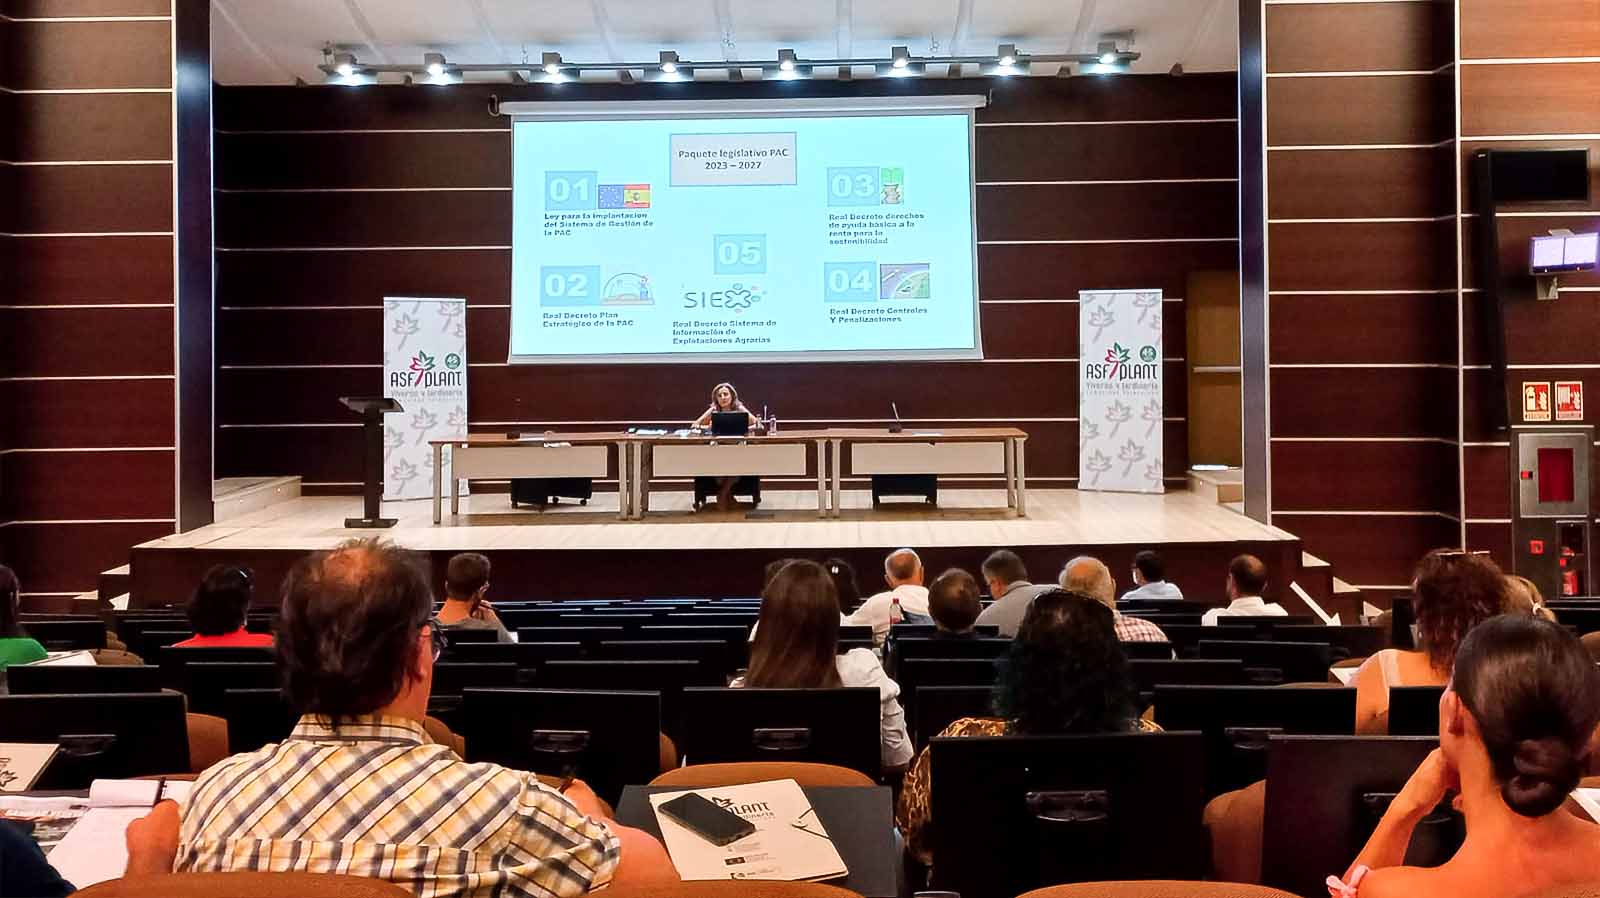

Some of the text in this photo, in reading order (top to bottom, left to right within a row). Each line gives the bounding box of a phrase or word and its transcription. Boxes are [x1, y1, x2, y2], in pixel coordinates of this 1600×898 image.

[679, 148, 790, 160] Paquete legislativo PAC
[705, 161, 728, 170] 2023
[738, 161, 762, 170] 2027
[550, 177, 590, 202] 01
[831, 174, 876, 198] 03
[544, 213, 560, 221] Ley
[582, 212, 591, 220] la
[829, 212, 925, 221] Real Decreto derechos
[559, 220, 594, 228] Sistema
[595, 219, 606, 228] de
[642, 219, 654, 227] de
[841, 221, 867, 230] ayuda
[906, 220, 915, 228] la
[554, 229, 572, 237] PAC
[829, 230, 852, 238] renta
[874, 229, 883, 237] la
[829, 237, 889, 246] sostenibilidad
[719, 240, 761, 265] 05
[544, 272, 589, 297] 02
[829, 268, 873, 293] 04
[542, 311, 619, 320] Real Decreto Plan
[829, 306, 928, 316] Real Decreto Controles
[593, 320, 605, 328] de
[606, 320, 615, 328] la
[616, 319, 635, 328] PAC
[672, 319, 777, 329] Real Decreto Sistema de
[829, 315, 903, 324] Y Penalizaciones
[725, 328, 736, 336] de
[672, 335, 772, 346] Explotaciones Agrarias
